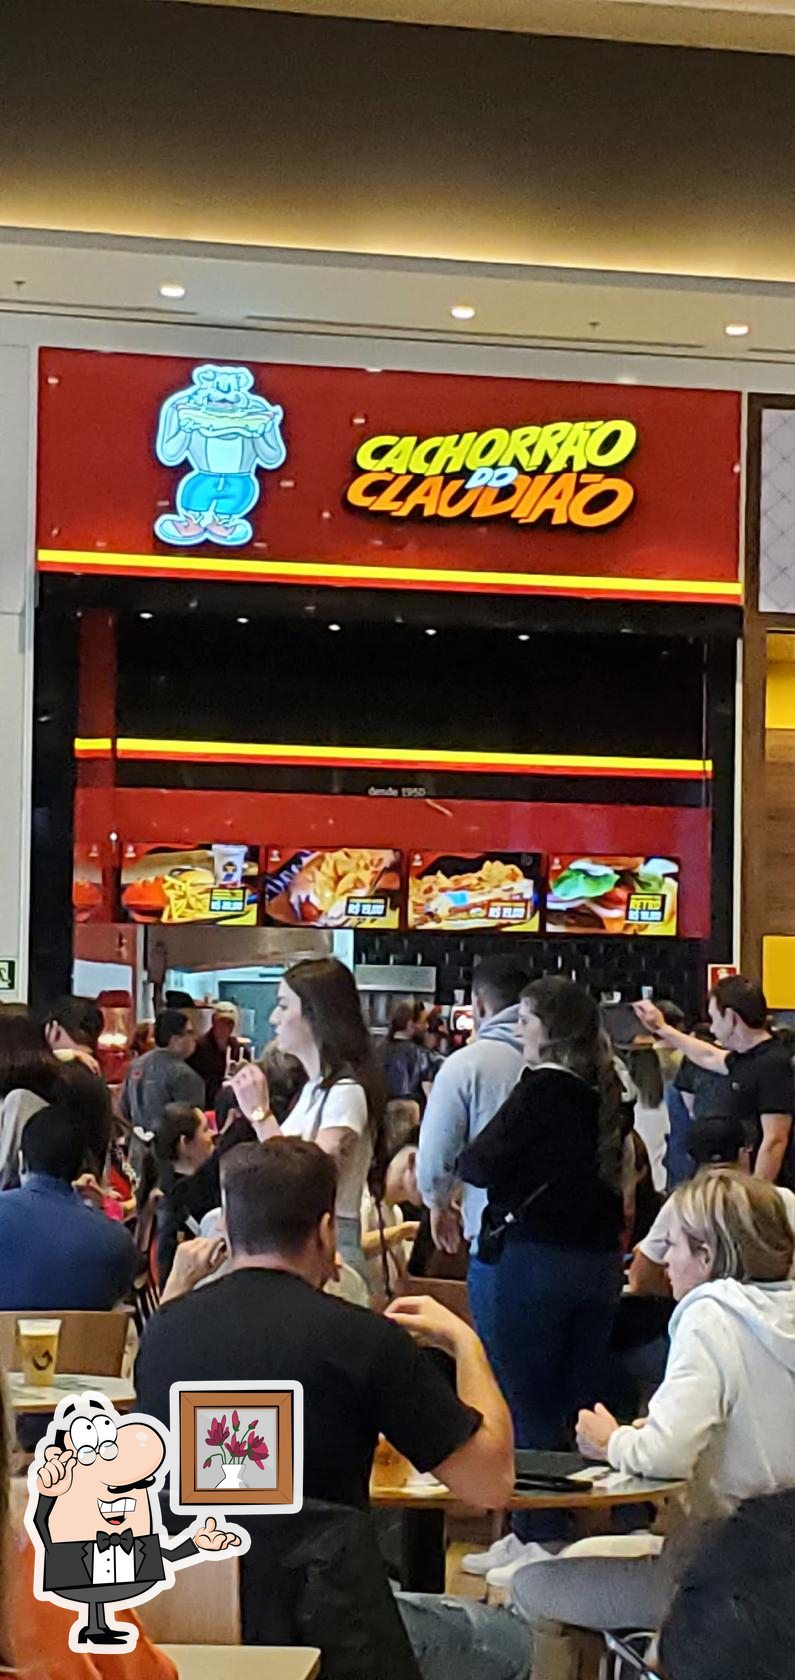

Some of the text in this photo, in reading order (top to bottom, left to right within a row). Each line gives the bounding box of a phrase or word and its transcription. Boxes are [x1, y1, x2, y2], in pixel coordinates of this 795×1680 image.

[355, 419, 637, 477] CACHORRÃO
[465, 466, 519, 489] DO
[346, 472, 634, 527] CLAUDIÃO
[368, 786, 399, 797] desde
